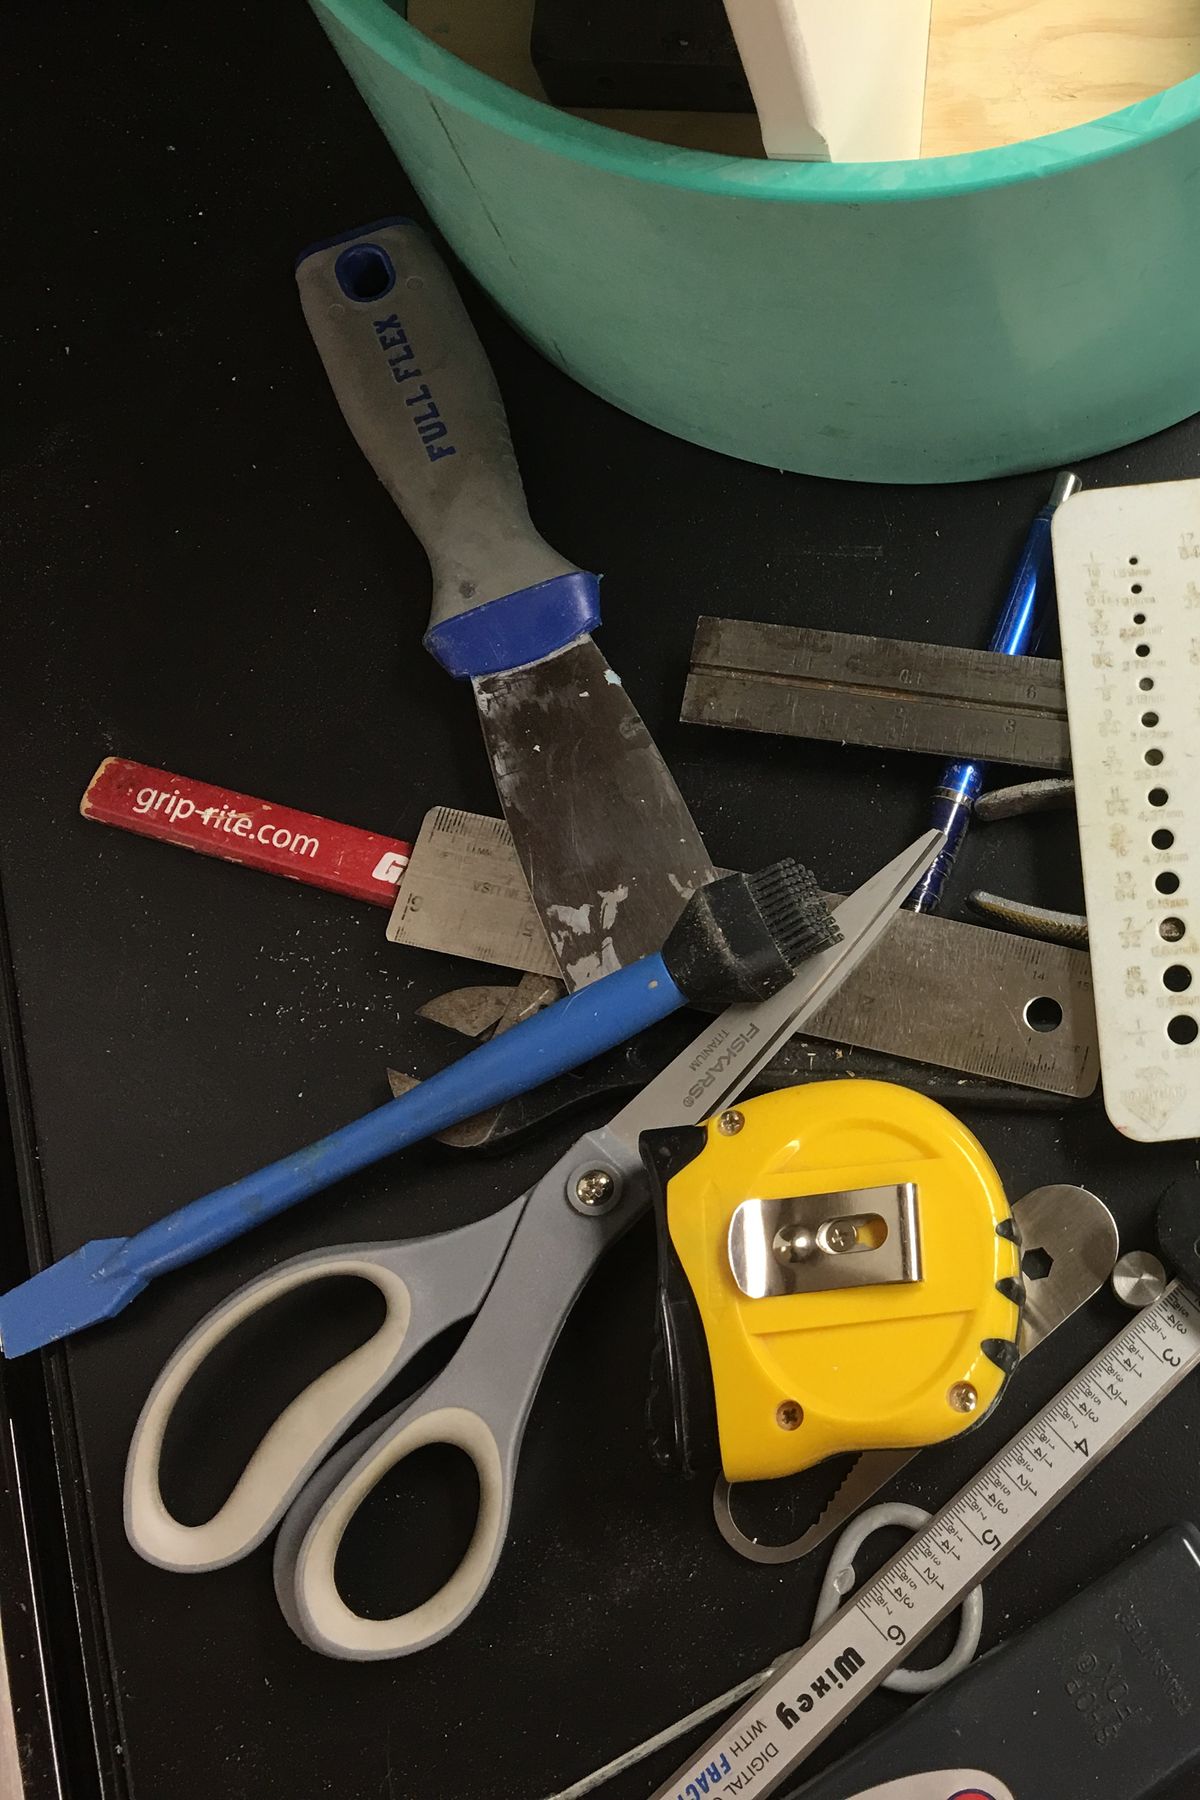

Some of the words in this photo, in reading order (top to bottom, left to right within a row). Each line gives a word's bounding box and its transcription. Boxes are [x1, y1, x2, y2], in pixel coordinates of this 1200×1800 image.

[373, 316, 424, 383] FLEX
[405, 384, 455, 461] FULL
[132, 787, 320, 858] grip-rite.com
[689, 1029, 730, 1071] TITANIUM
[1163, 1348, 1181, 1367] 3
[1073, 1438, 1089, 1457] 4
[982, 1529, 1001, 1551] 5
[887, 1624, 906, 1646] 6
[776, 1646, 865, 1731] Wixey
[729, 1720, 767, 1758] WITH
[677, 1752, 732, 1800] FRAC
[723, 1742, 779, 1795] DIGITAL
